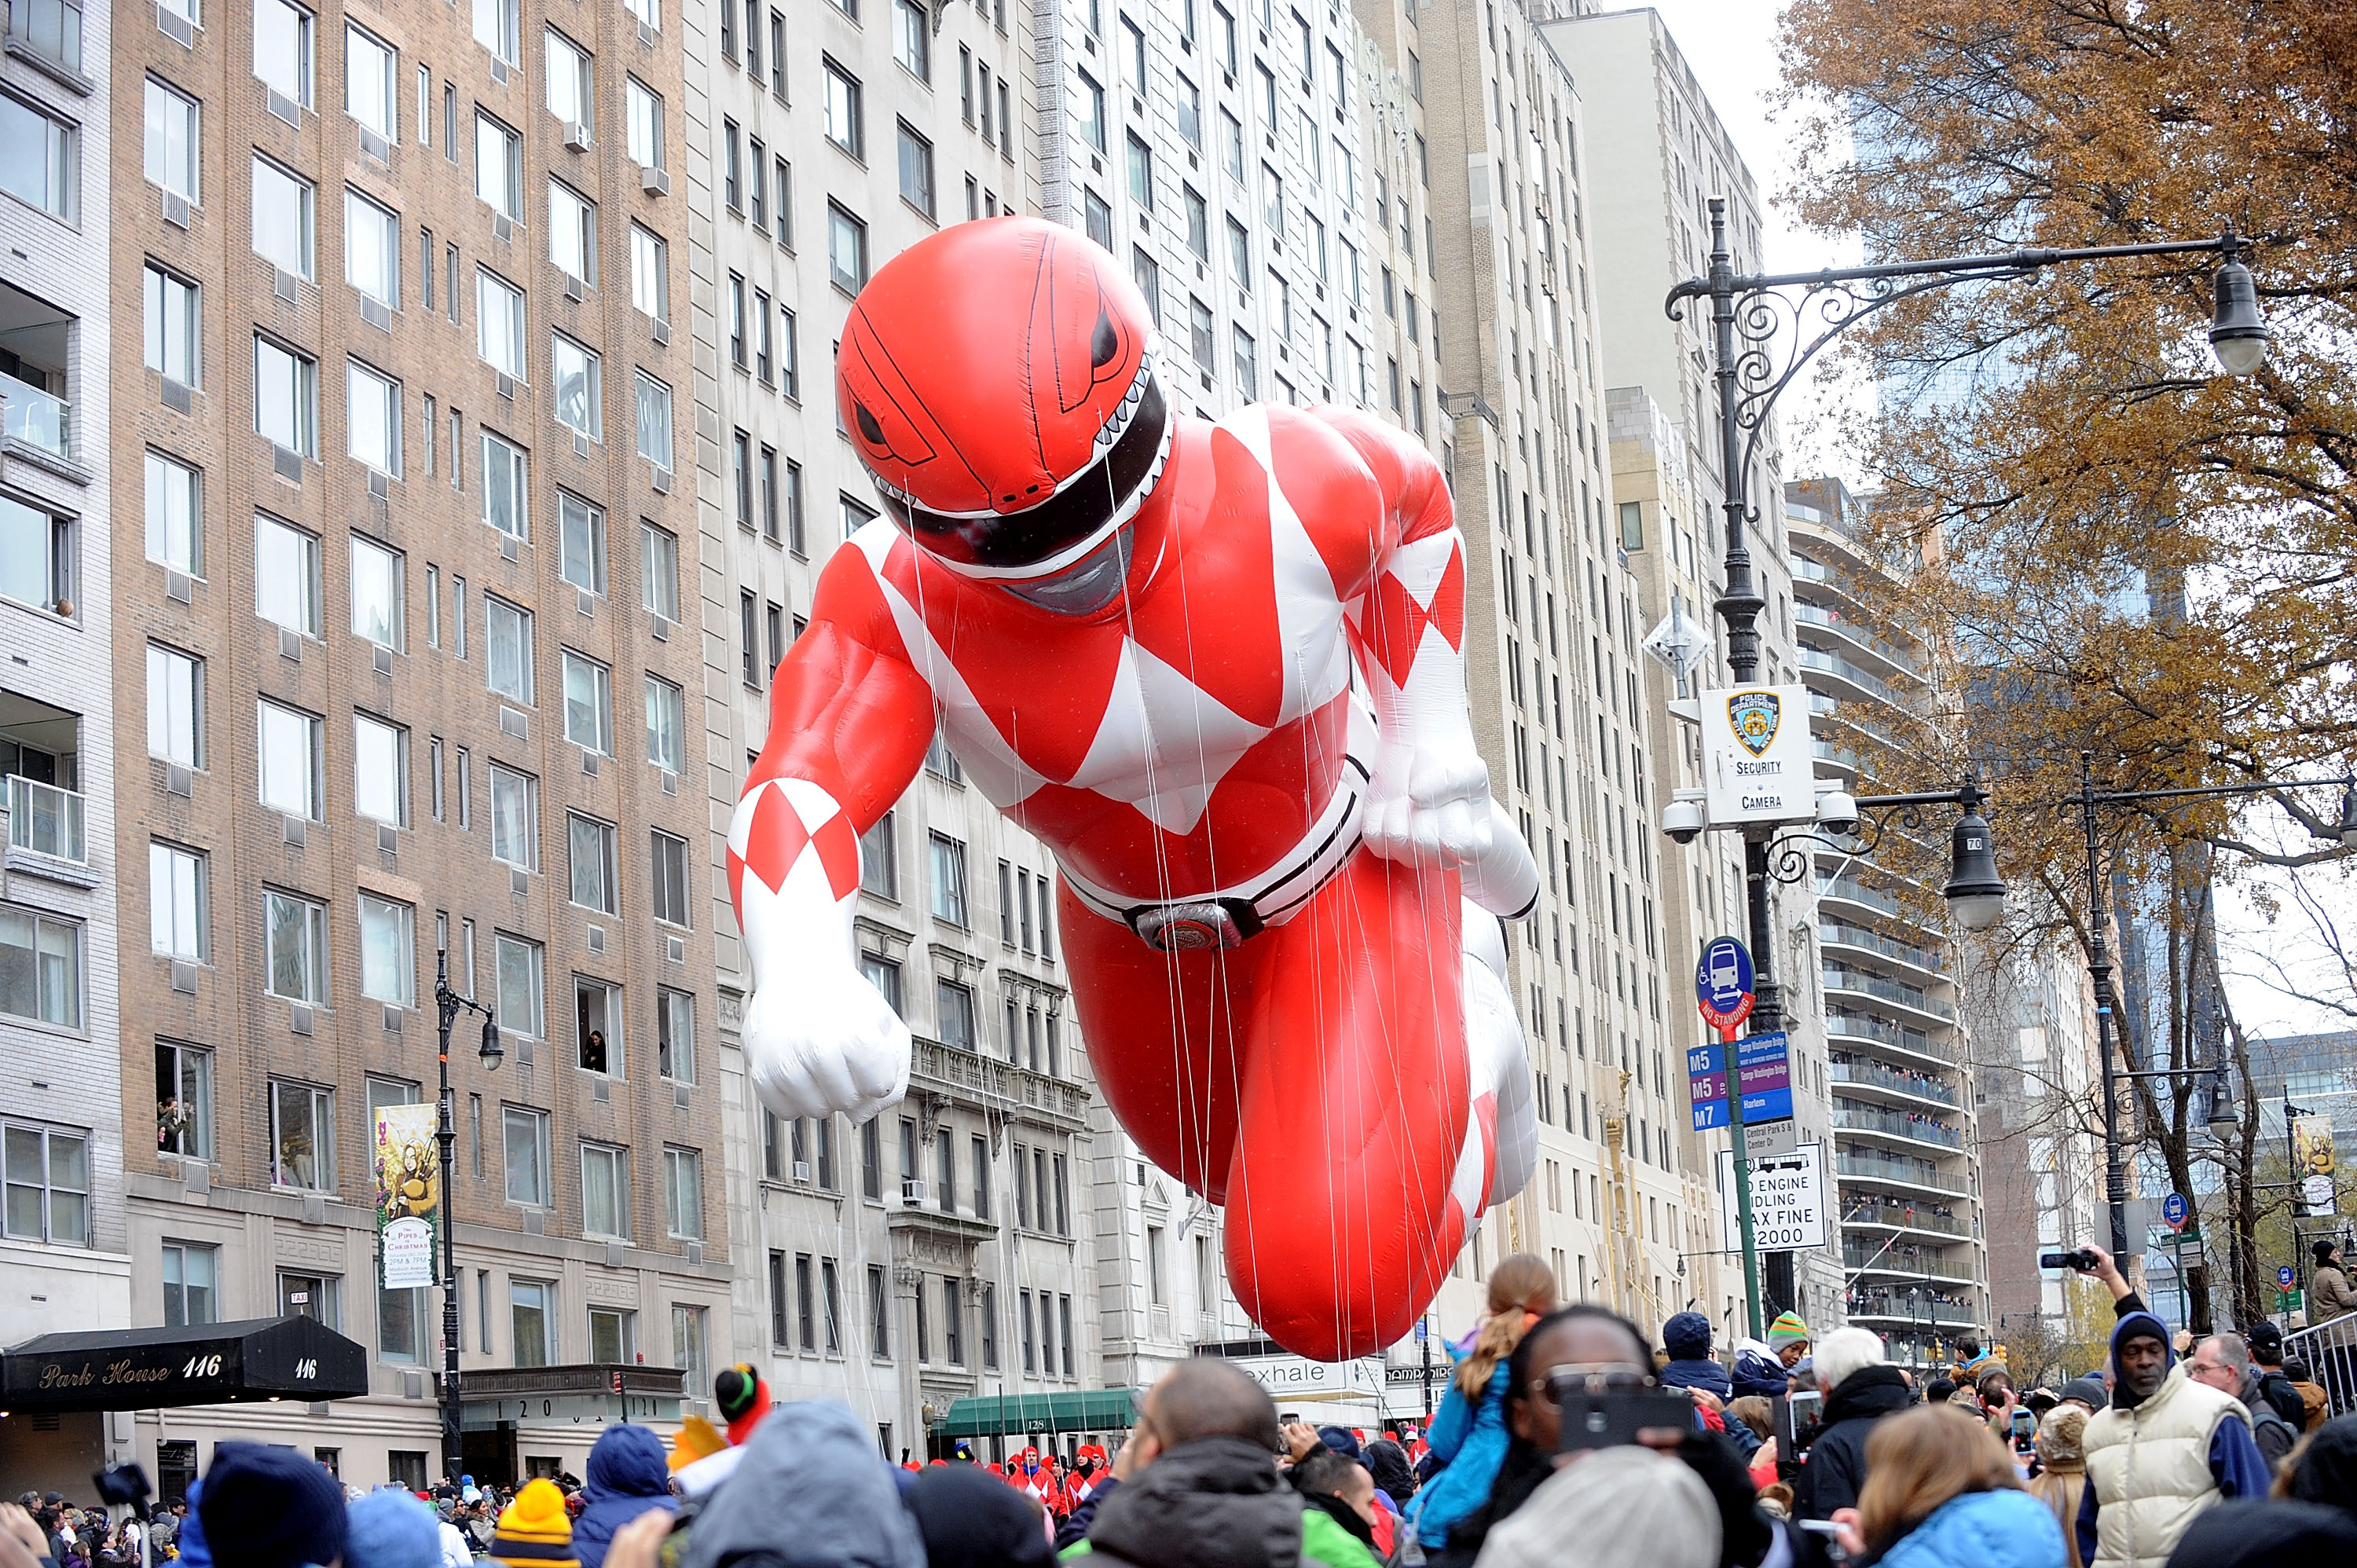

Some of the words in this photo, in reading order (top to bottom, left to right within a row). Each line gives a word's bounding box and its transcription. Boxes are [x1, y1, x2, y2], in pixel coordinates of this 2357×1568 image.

[1739, 694, 1768, 703] POLICE
[1730, 701, 1778, 714] DEPARTMENT
[1732, 720, 1743, 736] CITY
[1743, 737, 1751, 746] OF
[1760, 734, 1772, 749] NEW
[1769, 714, 1779, 732] YORK
[1736, 760, 1781, 775] SECURITY
[1742, 796, 1782, 809] CAMERA
[1968, 839, 1981, 848] 70
[1702, 1004, 1714, 1019] NO
[1714, 998, 1750, 1026] STANDING
[1689, 1050, 1710, 1072] M5
[1692, 1077, 1713, 1099] M5
[1743, 1098, 1765, 1109] Harlem
[1694, 1105, 1714, 1127] M7
[1747, 1127, 1766, 1138] Central
[1767, 1123, 1780, 1135] Park
[1781, 1123, 1786, 1133] S
[1787, 1123, 1791, 1131] &
[1747, 1140, 1765, 1150] Center
[1766, 1137, 1773, 1147] Dr
[1759, 1176, 1809, 1192] ENGINE
[1750, 1193, 1795, 1208] IDLING
[1777, 1208, 1813, 1225] FINE
[1753, 1228, 1803, 1245] 2000
[292, 1293, 307, 1302] TAXI
[38, 1362, 96, 1389] Park
[102, 1358, 173, 1385] House
[182, 1354, 222, 1379] 116
[295, 1357, 317, 1379] 116
[497, 1398, 552, 1419] 120
[632, 1397, 657, 1416] 120
[1028, 1419, 1044, 1430] 128
